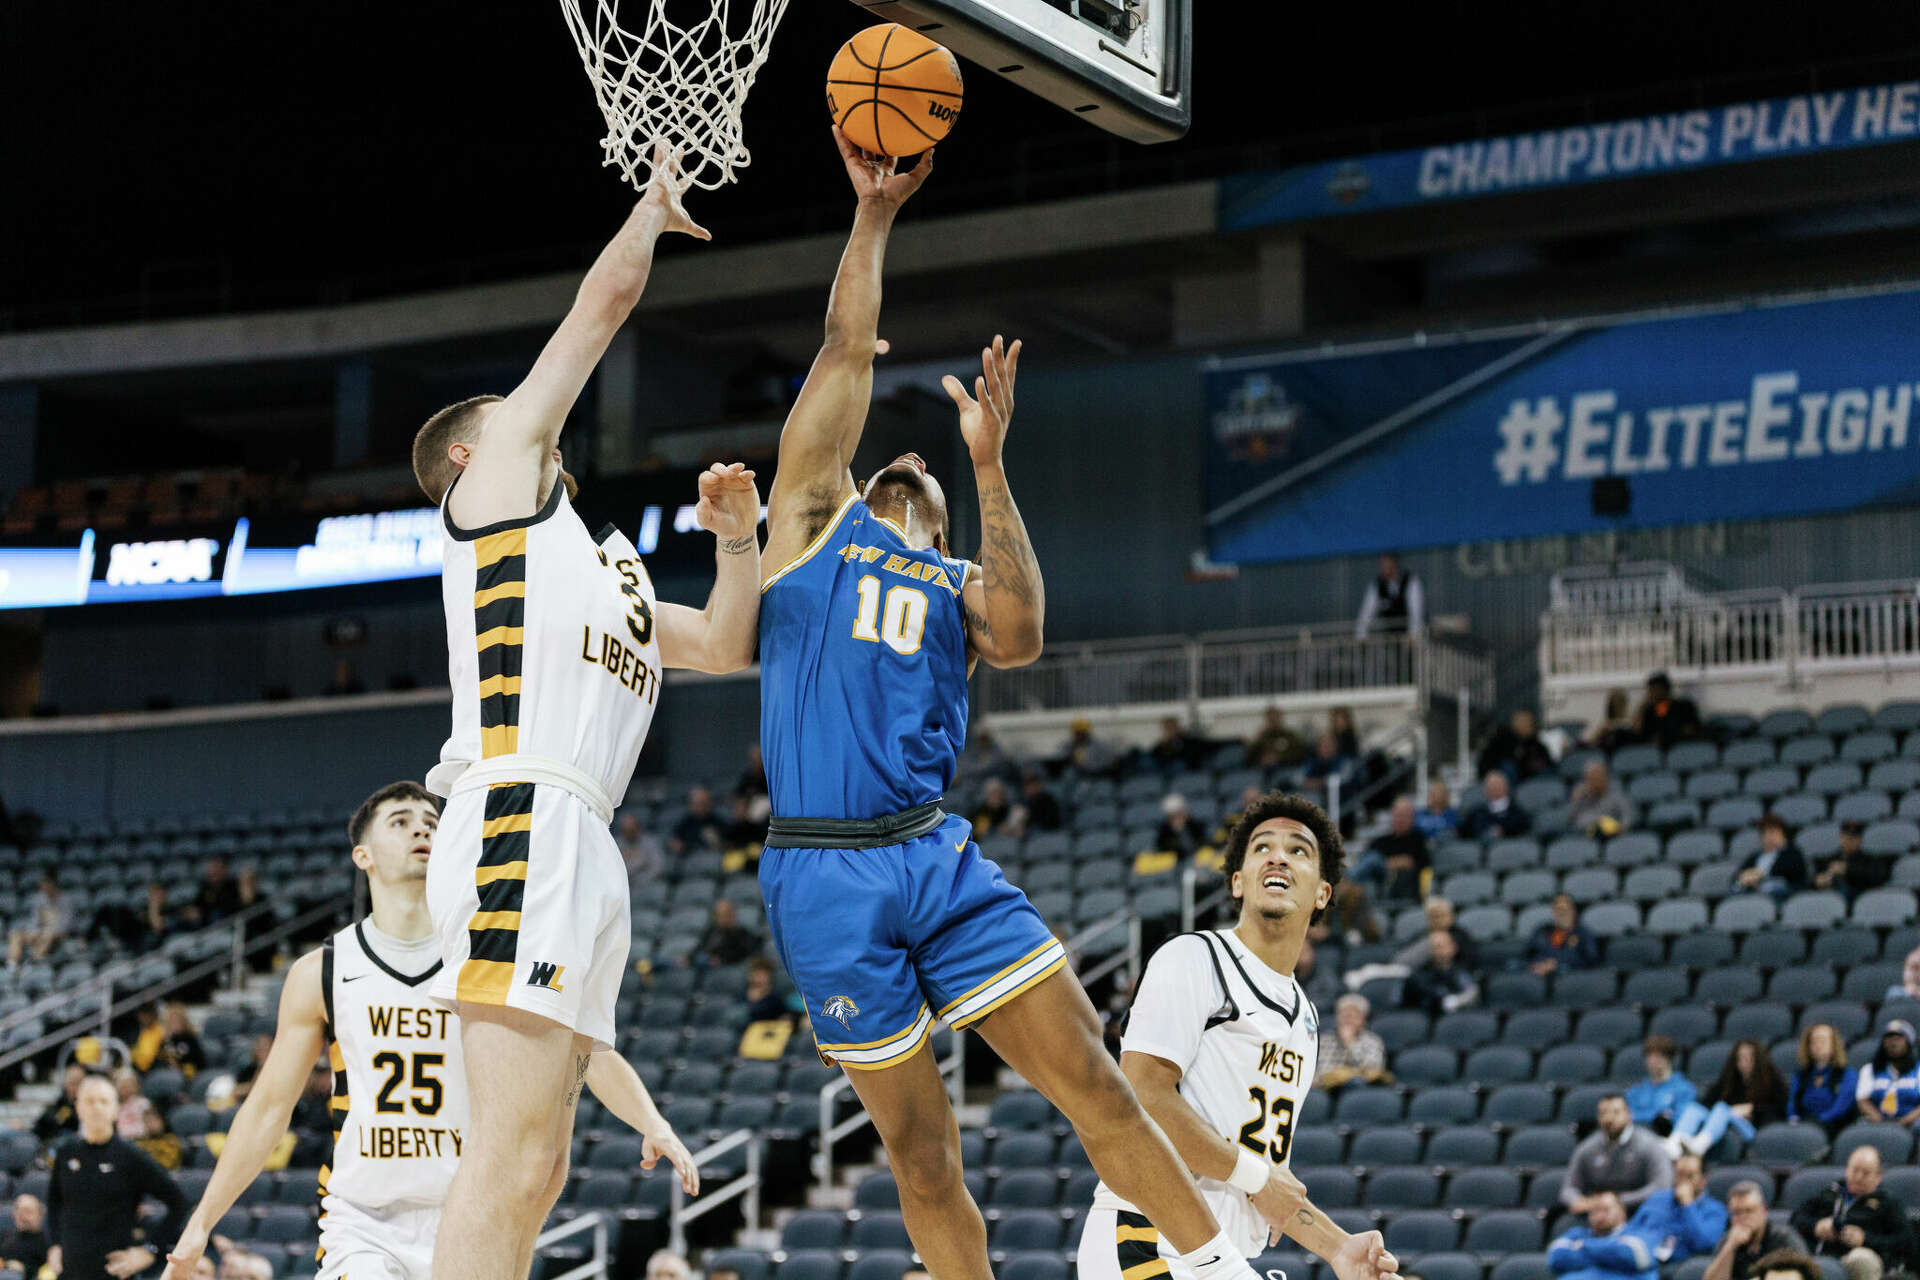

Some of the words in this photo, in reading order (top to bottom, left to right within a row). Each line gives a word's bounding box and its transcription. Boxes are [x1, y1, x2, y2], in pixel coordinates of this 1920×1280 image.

[1417, 109, 1710, 197] CHAMPIONS
[1720, 93, 1845, 155] PLAY
[1852, 82, 1920, 139] HE
[1494, 371, 1920, 485] #ELITEEIGH
[852, 574, 929, 656] 10
[581, 624, 662, 706] LIBERT
[526, 961, 567, 993] WL
[368, 1005, 453, 1040] WEST
[372, 1050, 445, 1116] 25
[1258, 1041, 1304, 1088] WEST
[359, 1124, 463, 1159] LIBERTY
[1238, 1085, 1294, 1167] 23
